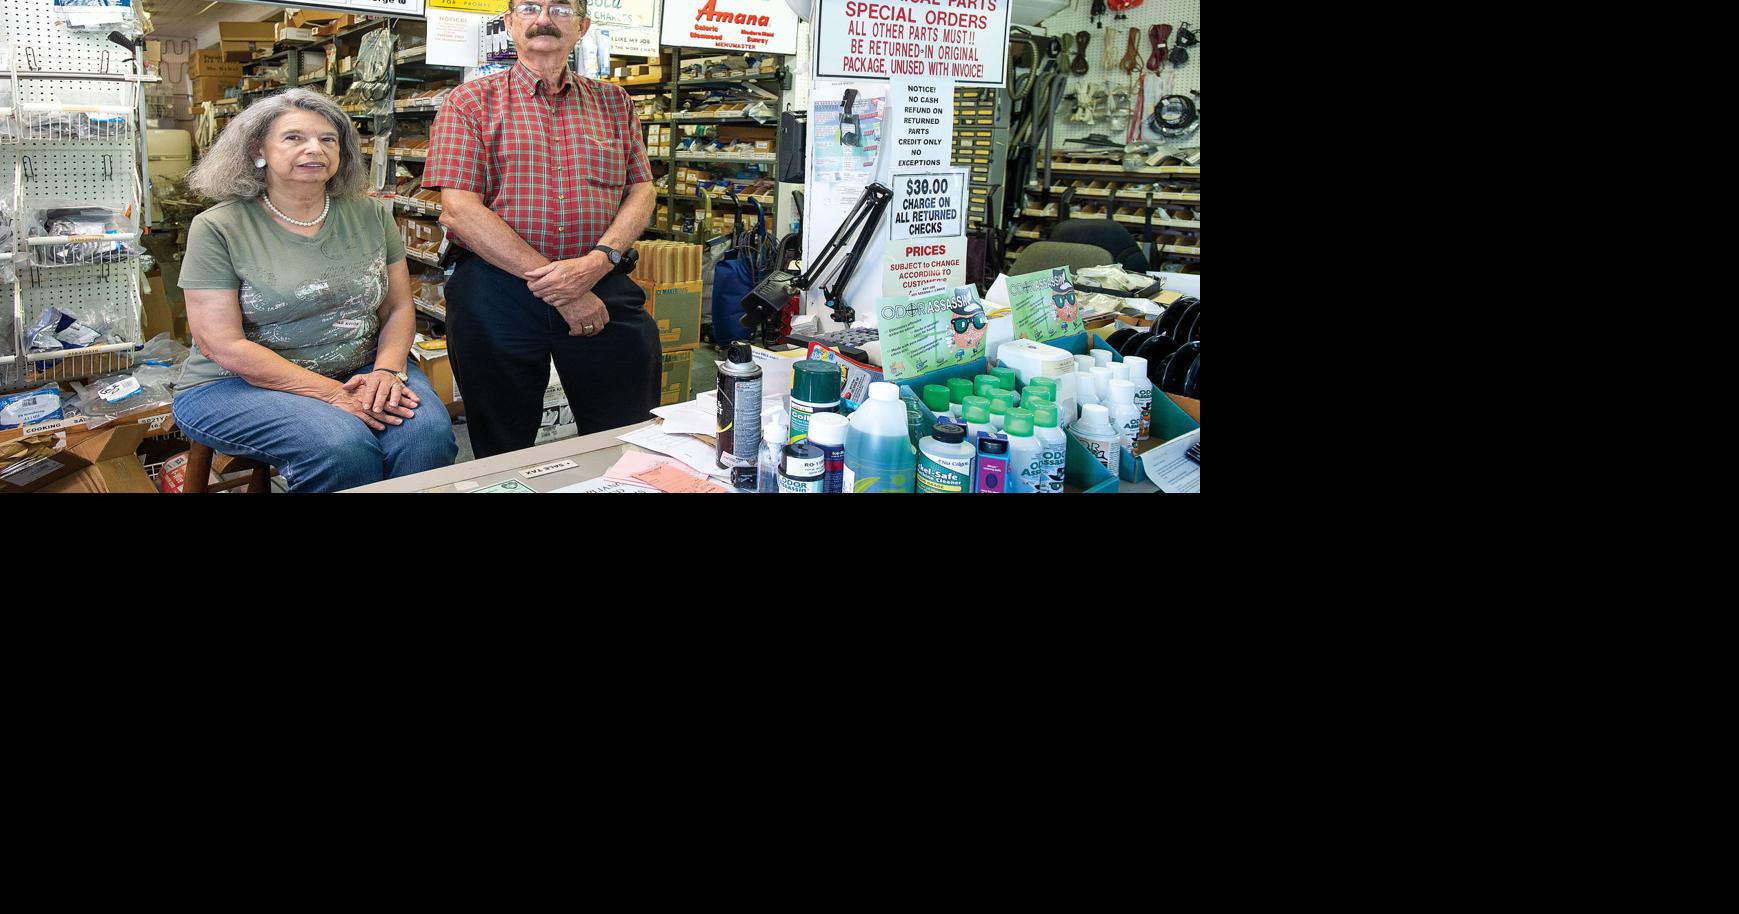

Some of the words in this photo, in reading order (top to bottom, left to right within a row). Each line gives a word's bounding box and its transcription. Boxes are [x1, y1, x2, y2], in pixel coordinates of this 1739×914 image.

[695, 0, 770, 27] Amana
[845, 2, 917, 23] SPECIAL
[925, 10, 988, 30] ORDERS
[848, 20, 867, 37] ALL
[872, 22, 905, 40] OTHER
[908, 25, 939, 42] PARTS
[715, 41, 756, 50] MENUMASTER
[850, 38, 864, 55] BE
[868, 40, 920, 59] RETURNED
[924, 43, 934, 60] IN
[938, 45, 979, 62] ORIGINAL
[843, 56, 888, 76] PACKAGE,
[890, 58, 925, 75] UNUSED
[928, 61, 949, 77] WITH
[951, 62, 984, 78] INVOICE!
[907, 85, 937, 93] NOTICE!
[920, 96, 939, 104] CASH
[904, 106, 931, 114] REFUND
[898, 159, 941, 167] EXCEPTIONS
[906, 178, 949, 197] $30.00
[902, 197, 936, 210] CHARGE
[938, 196, 950, 208] ON
[895, 211, 910, 224] ALL
[912, 208, 957, 222] RETURNED
[908, 222, 942, 235] CHECKS
[905, 244, 946, 257] PRICES
[890, 261, 921, 271] SUBJECT
[923, 261, 930, 269] to
[931, 259, 960, 268] CHANGE
[899, 269, 941, 280] ACCORDING
[942, 268, 951, 276] TO
[881, 302, 927, 320] ODOR
[927, 294, 972, 314] ASSASSIN
[26, 422, 62, 434] COOKING
[525, 467, 542, 476] TAX
[782, 476, 807, 489] ODOR
[936, 477, 961, 485] Cleaner
